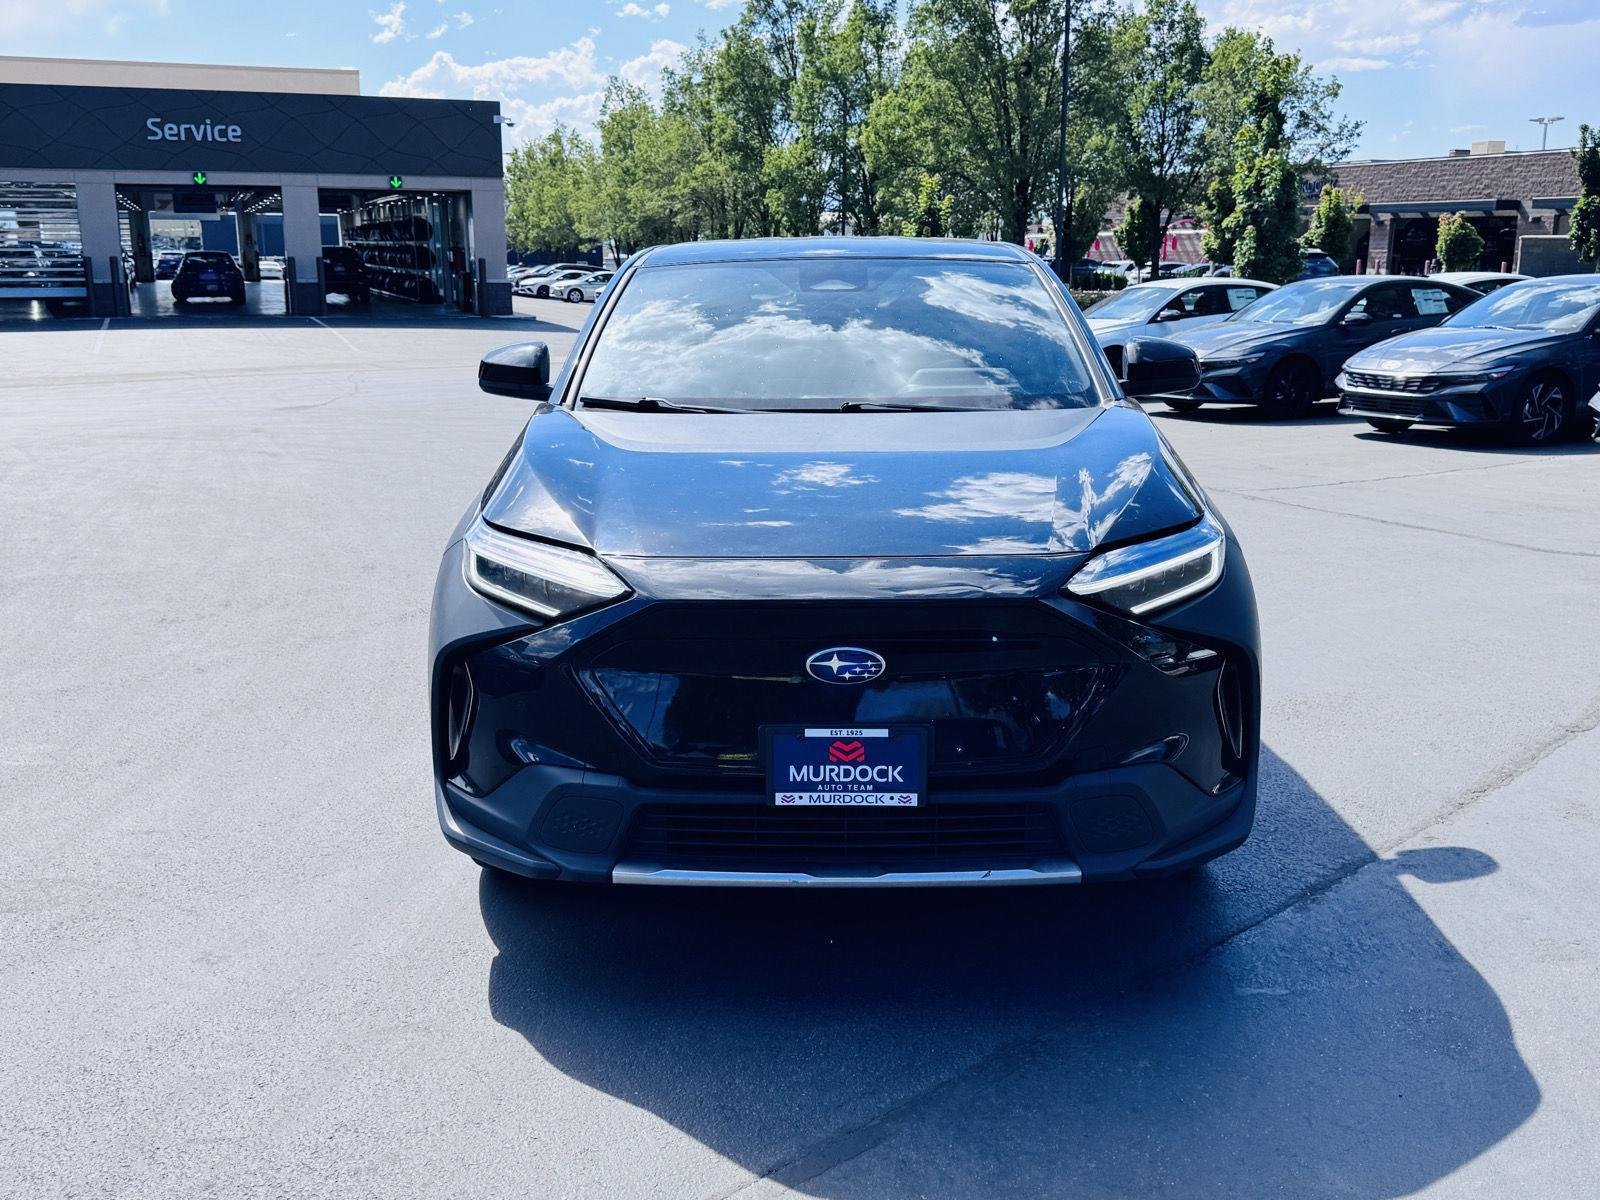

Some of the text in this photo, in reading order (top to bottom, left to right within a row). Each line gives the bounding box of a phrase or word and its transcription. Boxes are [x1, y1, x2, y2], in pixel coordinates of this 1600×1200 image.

[146, 117, 242, 142] Service
[789, 765, 904, 782] MURDOCK
[808, 794, 885, 804] MURDOCK
